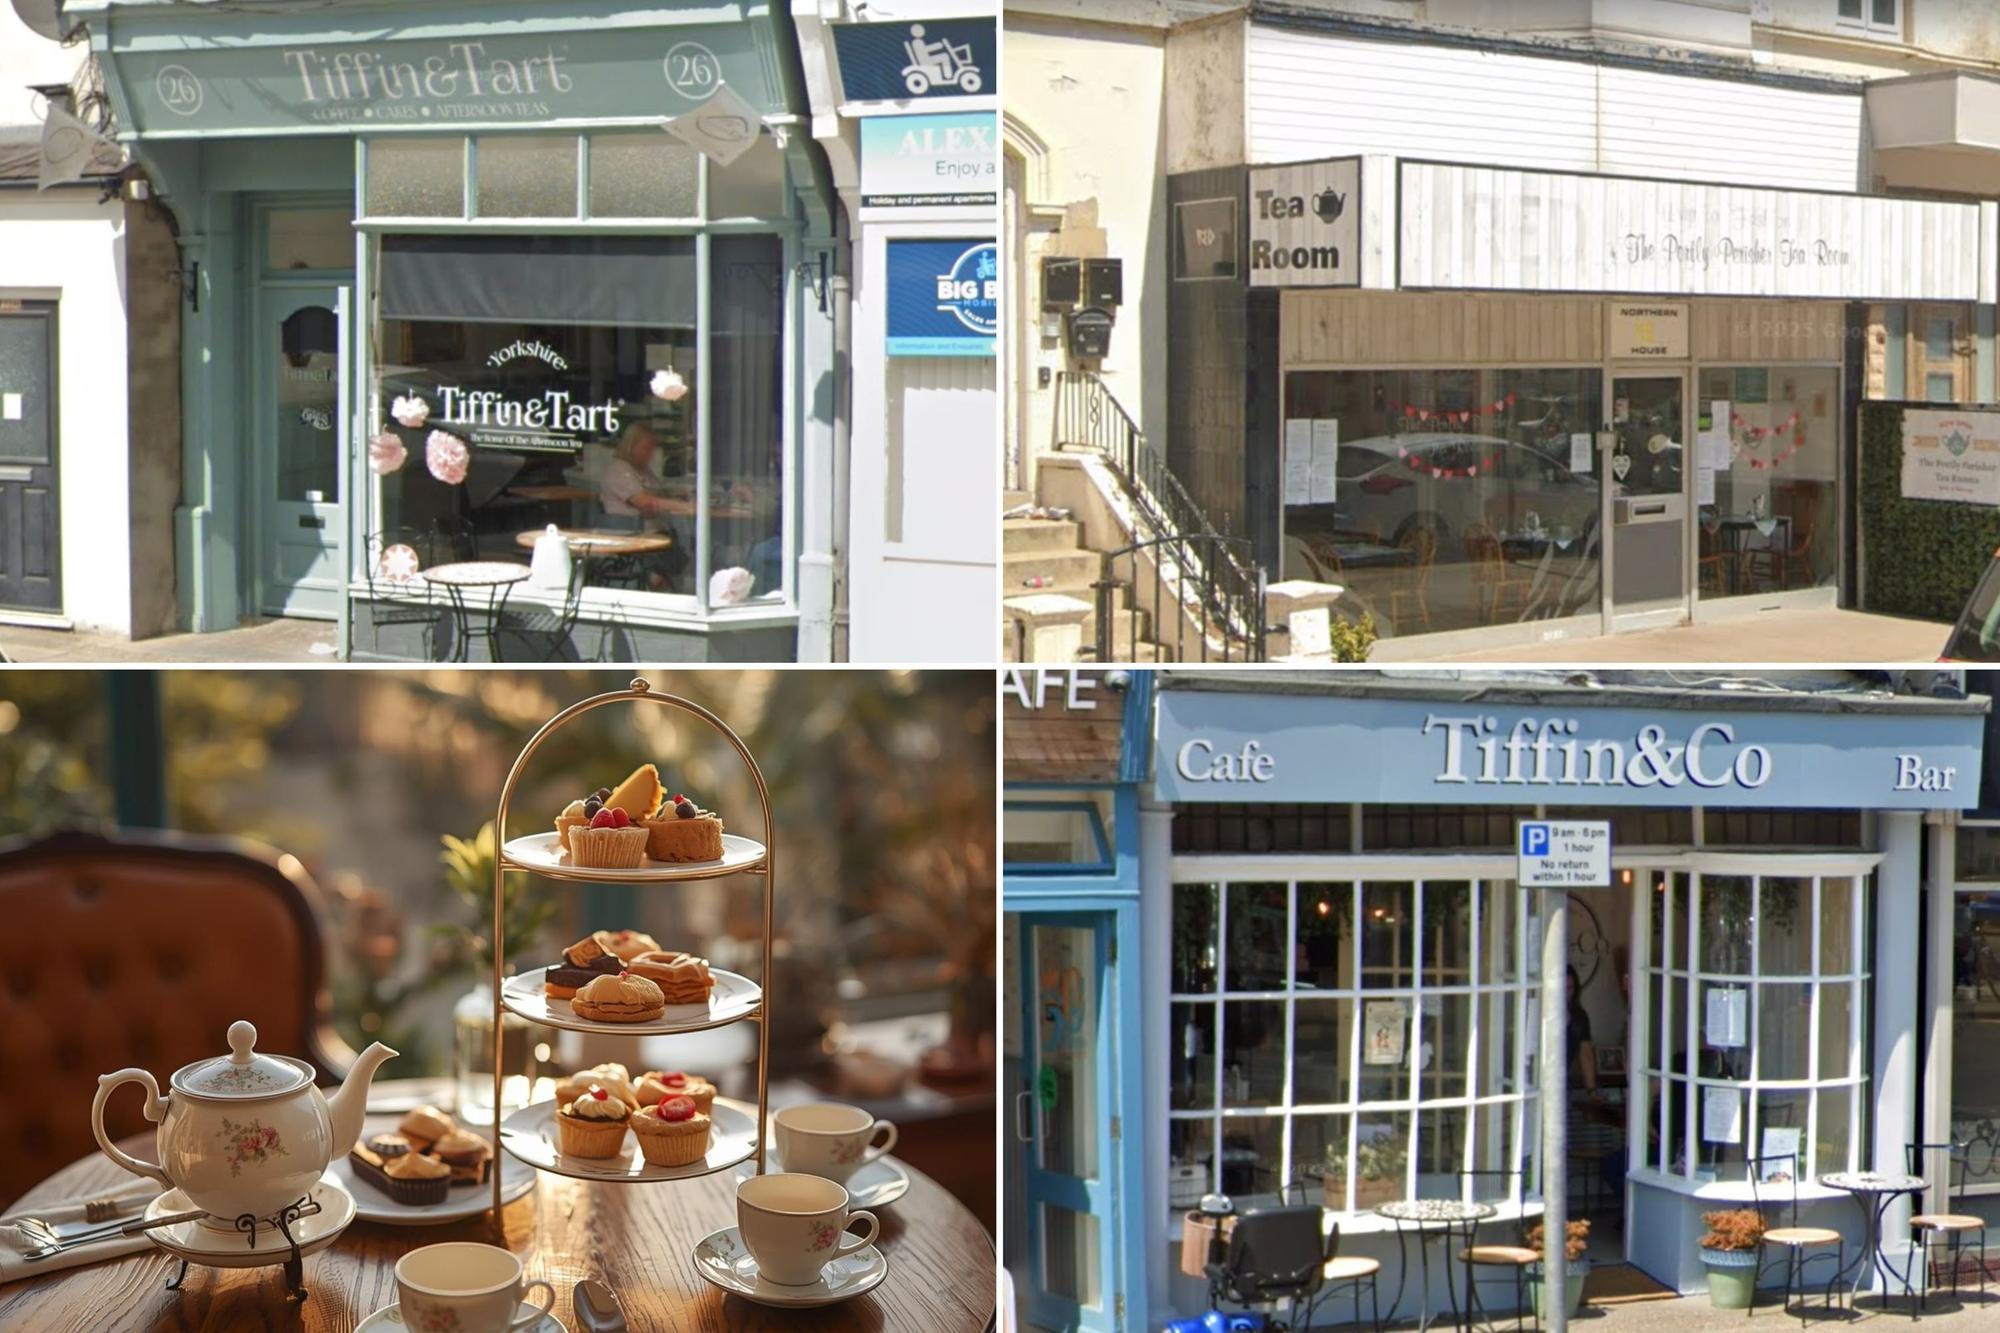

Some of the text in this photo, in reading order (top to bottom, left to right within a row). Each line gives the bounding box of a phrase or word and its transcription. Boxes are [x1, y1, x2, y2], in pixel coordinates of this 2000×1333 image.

[285, 41, 574, 101] Tiffin&Tart
[674, 50, 711, 87] 26
[163, 76, 196, 103] 26
[376, 103, 417, 119] CAKES
[898, 126, 996, 156] ALEX
[936, 160, 981, 178] Enjoy
[897, 196, 912, 205] and
[1255, 189, 1304, 221] Tea
[1252, 240, 1340, 269] Room
[1625, 233, 1654, 264] The
[938, 280, 978, 300] BIG
[1620, 308, 1678, 317] NORTHERN
[489, 339, 565, 370] Yorkshire
[1631, 346, 1667, 354] HOUSE
[437, 385, 619, 432] Tiffin&Tart
[1003, 670, 1096, 709] AFE
[1422, 713, 1772, 789] Tiffin&Co
[1894, 754, 1957, 793] Bar
[1528, 828, 1546, 854] P
[1564, 843, 1594, 852] 1 hour
[1532, 872, 1564, 880] within
[1574, 872, 1596, 880] hour
[1541, 860, 1590, 869] No return
